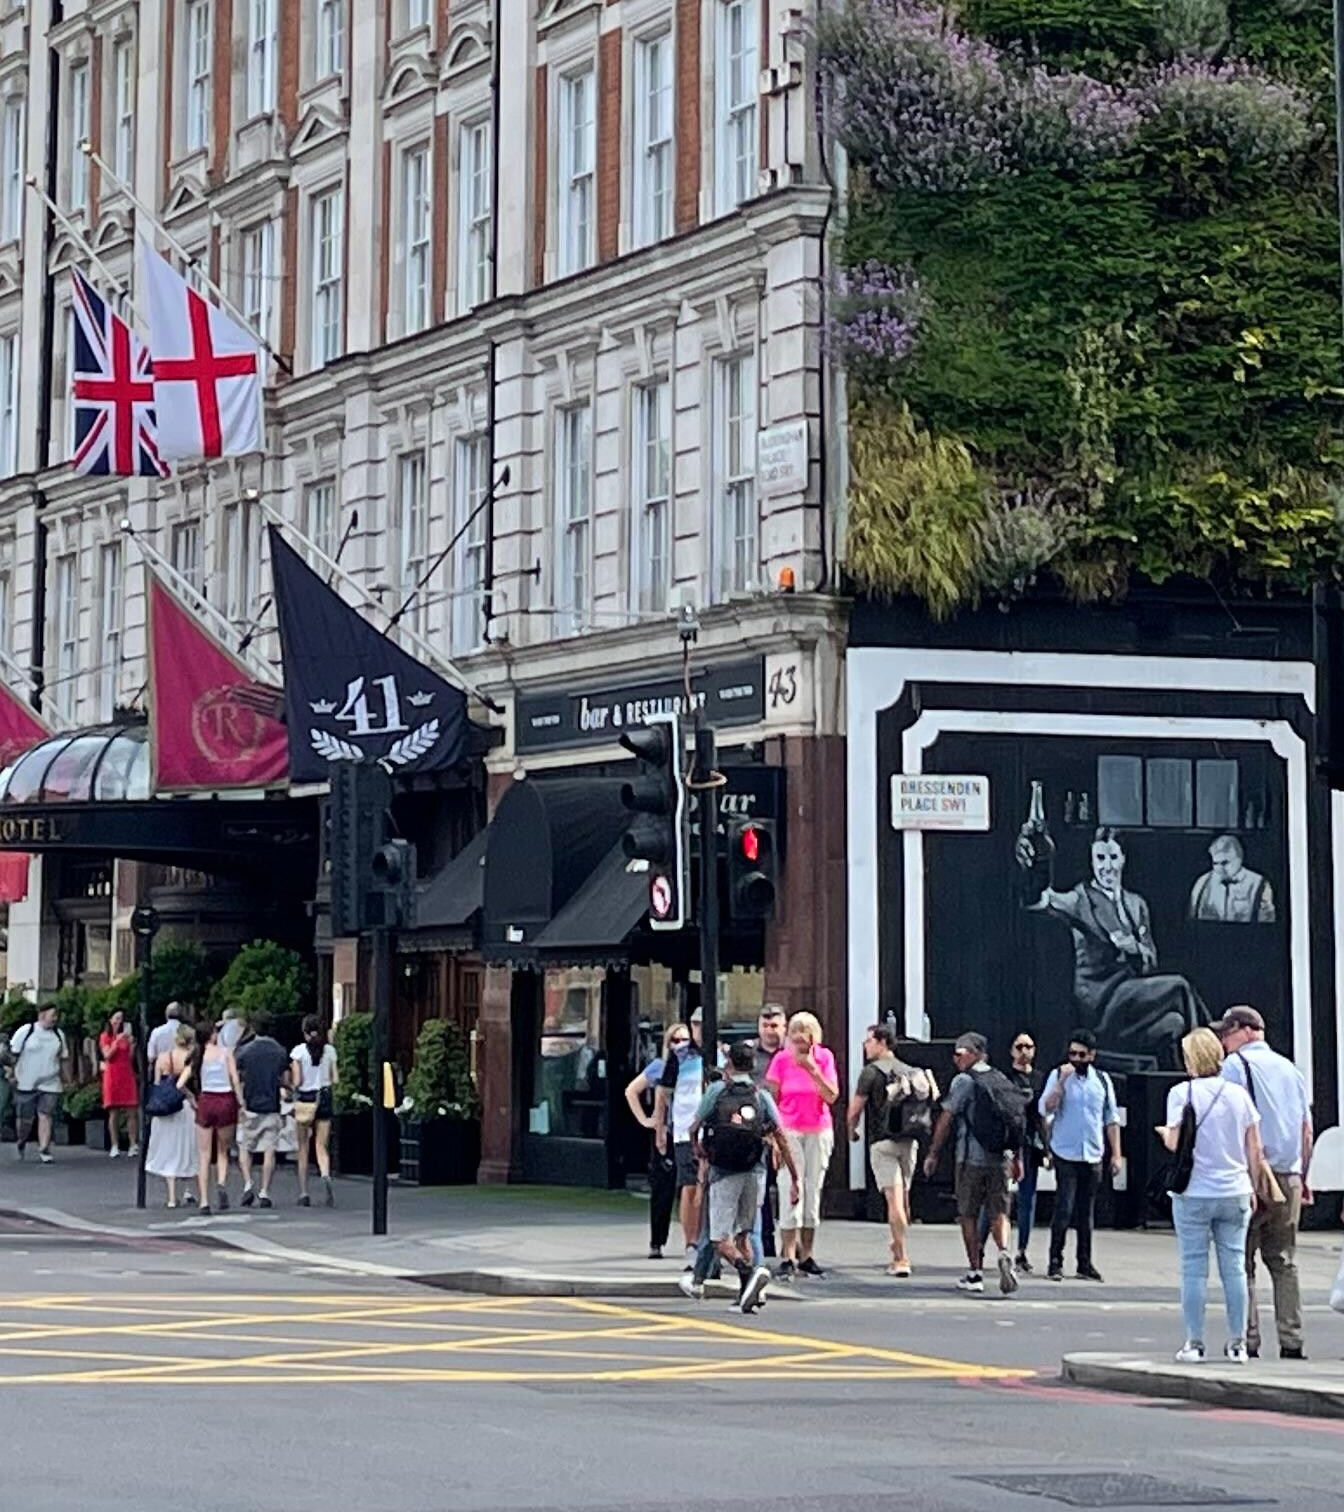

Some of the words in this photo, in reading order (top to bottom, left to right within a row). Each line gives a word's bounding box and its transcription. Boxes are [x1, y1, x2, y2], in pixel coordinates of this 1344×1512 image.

[335, 675, 409, 736] 41
[580, 697, 609, 731] bar
[901, 780, 981, 796] BRESSENDEN
[901, 797, 937, 811] PLACE
[942, 798, 966, 812] SW1
